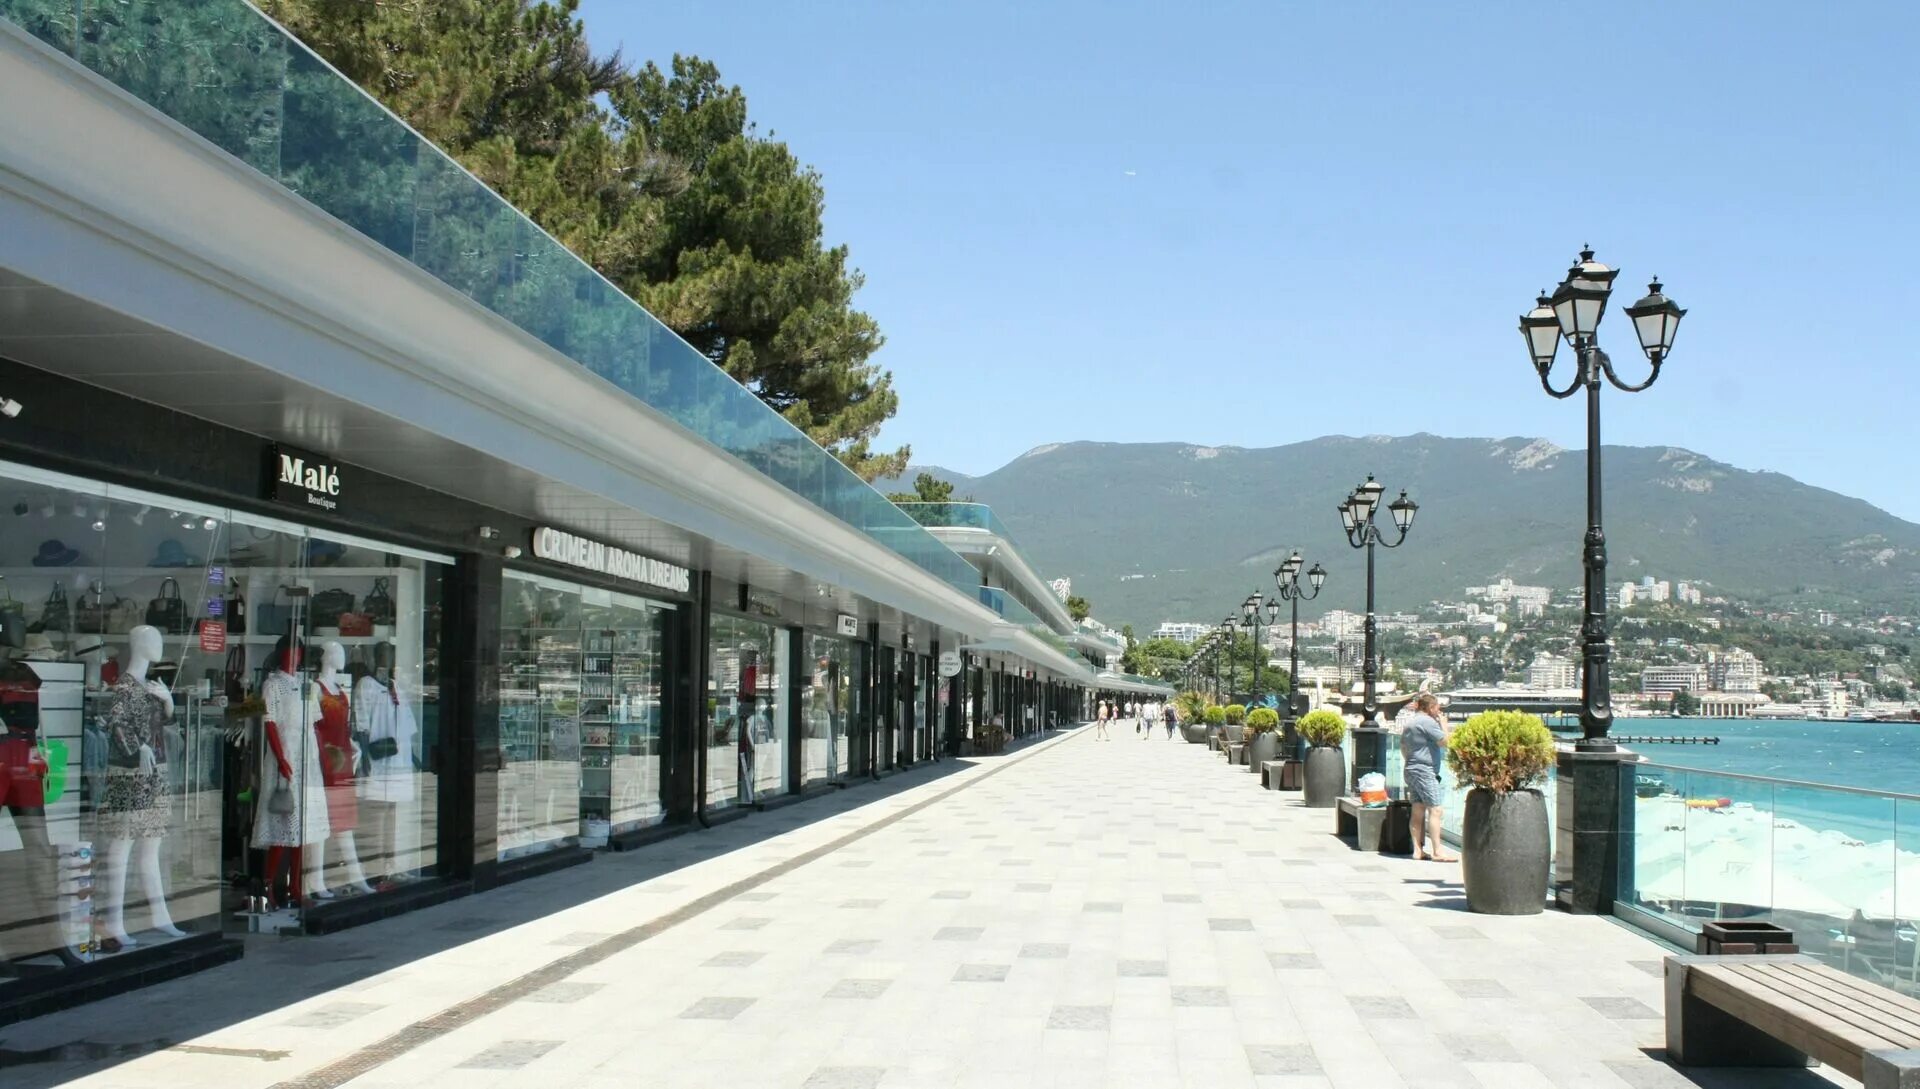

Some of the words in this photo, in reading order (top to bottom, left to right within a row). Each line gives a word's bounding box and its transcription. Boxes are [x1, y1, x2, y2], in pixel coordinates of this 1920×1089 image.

[280, 454, 340, 495] Malé
[308, 493, 336, 509] Boutique
[541, 526, 604, 571] CRIMEAN
[607, 546, 648, 582] AROMA
[650, 558, 689, 592] DREAMS
